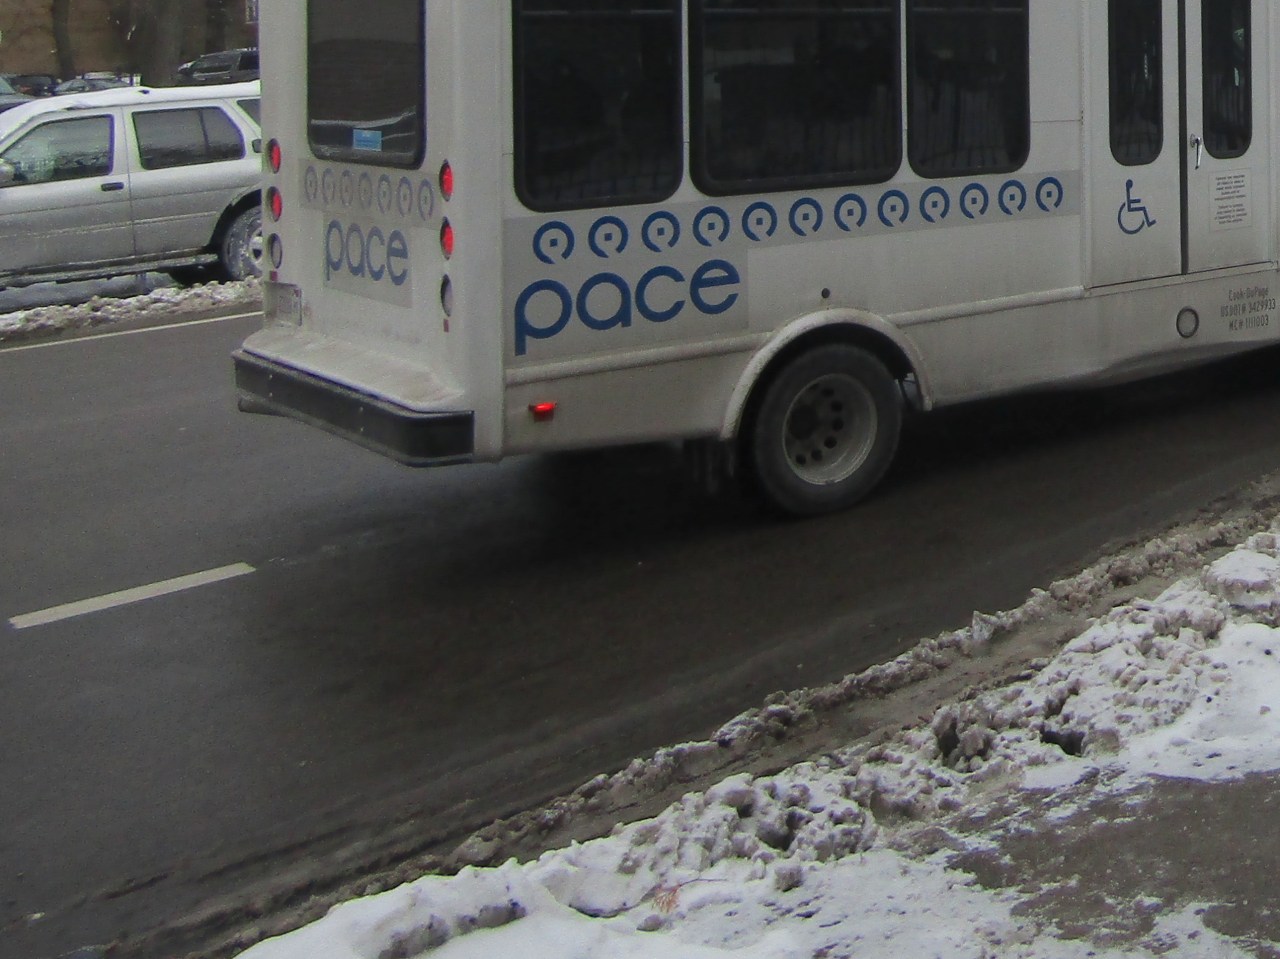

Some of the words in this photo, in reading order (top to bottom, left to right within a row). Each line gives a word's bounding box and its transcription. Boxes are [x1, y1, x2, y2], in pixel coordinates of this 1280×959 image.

[325, 219, 409, 286] pace
[514, 259, 741, 356] pace
[1248, 298, 1276, 314] 3429933
